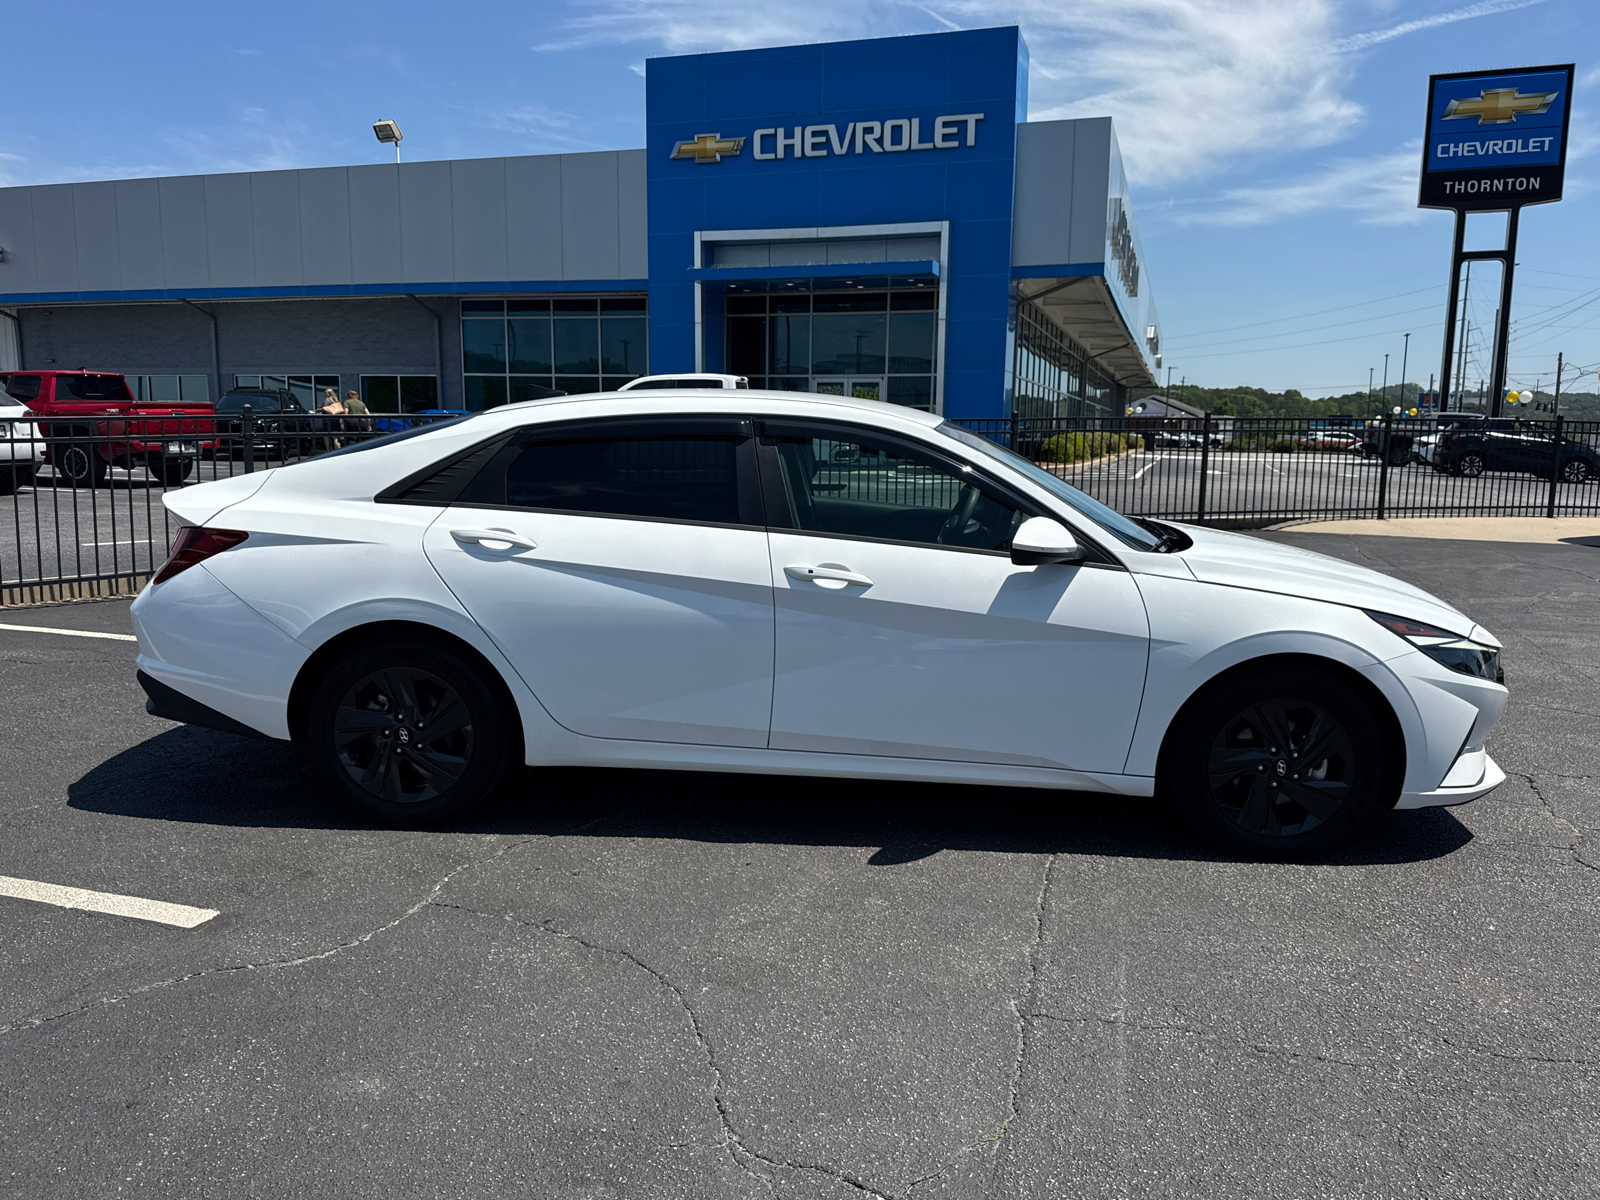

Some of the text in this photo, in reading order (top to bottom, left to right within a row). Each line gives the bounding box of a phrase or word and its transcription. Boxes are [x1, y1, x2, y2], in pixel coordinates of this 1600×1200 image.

[753, 113, 985, 160] CHEVROLET
[1437, 137, 1553, 158] CHEVROLET
[1444, 177, 1541, 194] THORNTON
